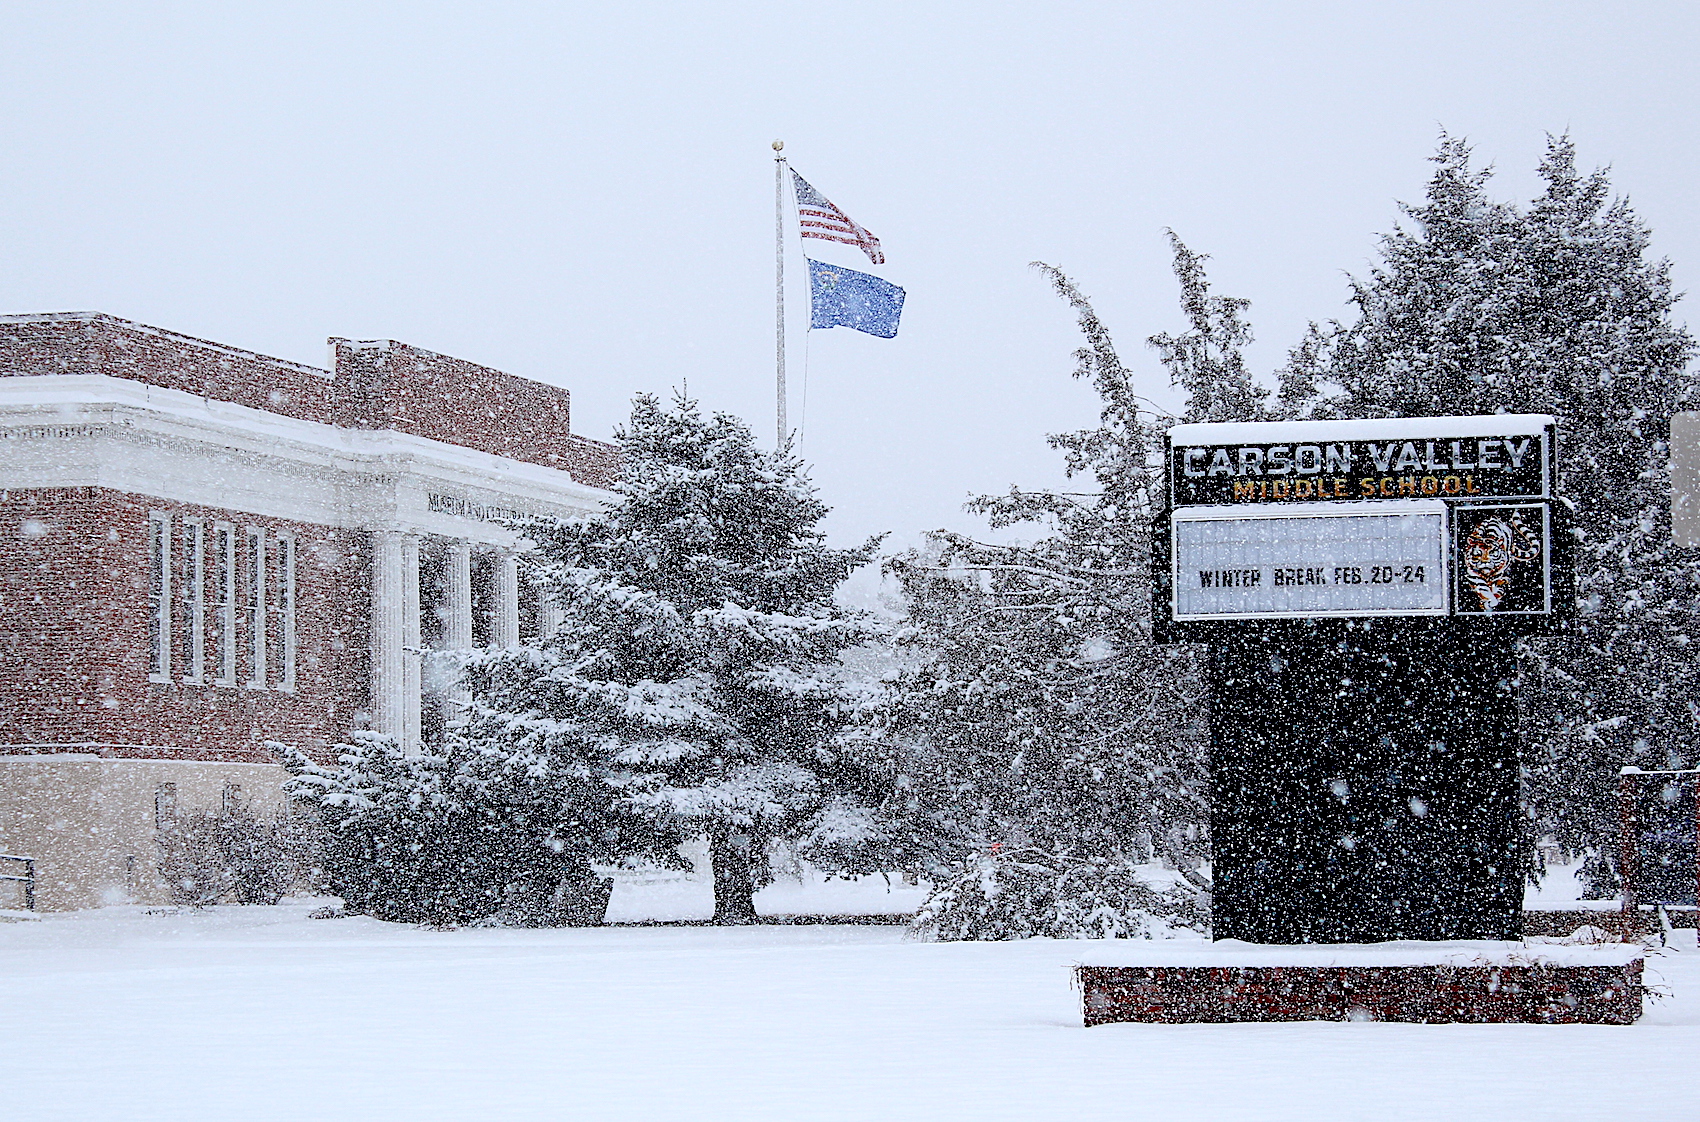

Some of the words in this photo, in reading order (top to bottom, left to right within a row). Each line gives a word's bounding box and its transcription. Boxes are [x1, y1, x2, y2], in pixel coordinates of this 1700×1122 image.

[1184, 444, 1351, 477] CARSON
[1367, 438, 1531, 472] VALLEY
[1234, 478, 1349, 500] MIDDLE
[1361, 474, 1480, 496] SCHOOL
[1200, 569, 1261, 588] WINTER
[1274, 567, 1326, 587] BREAK
